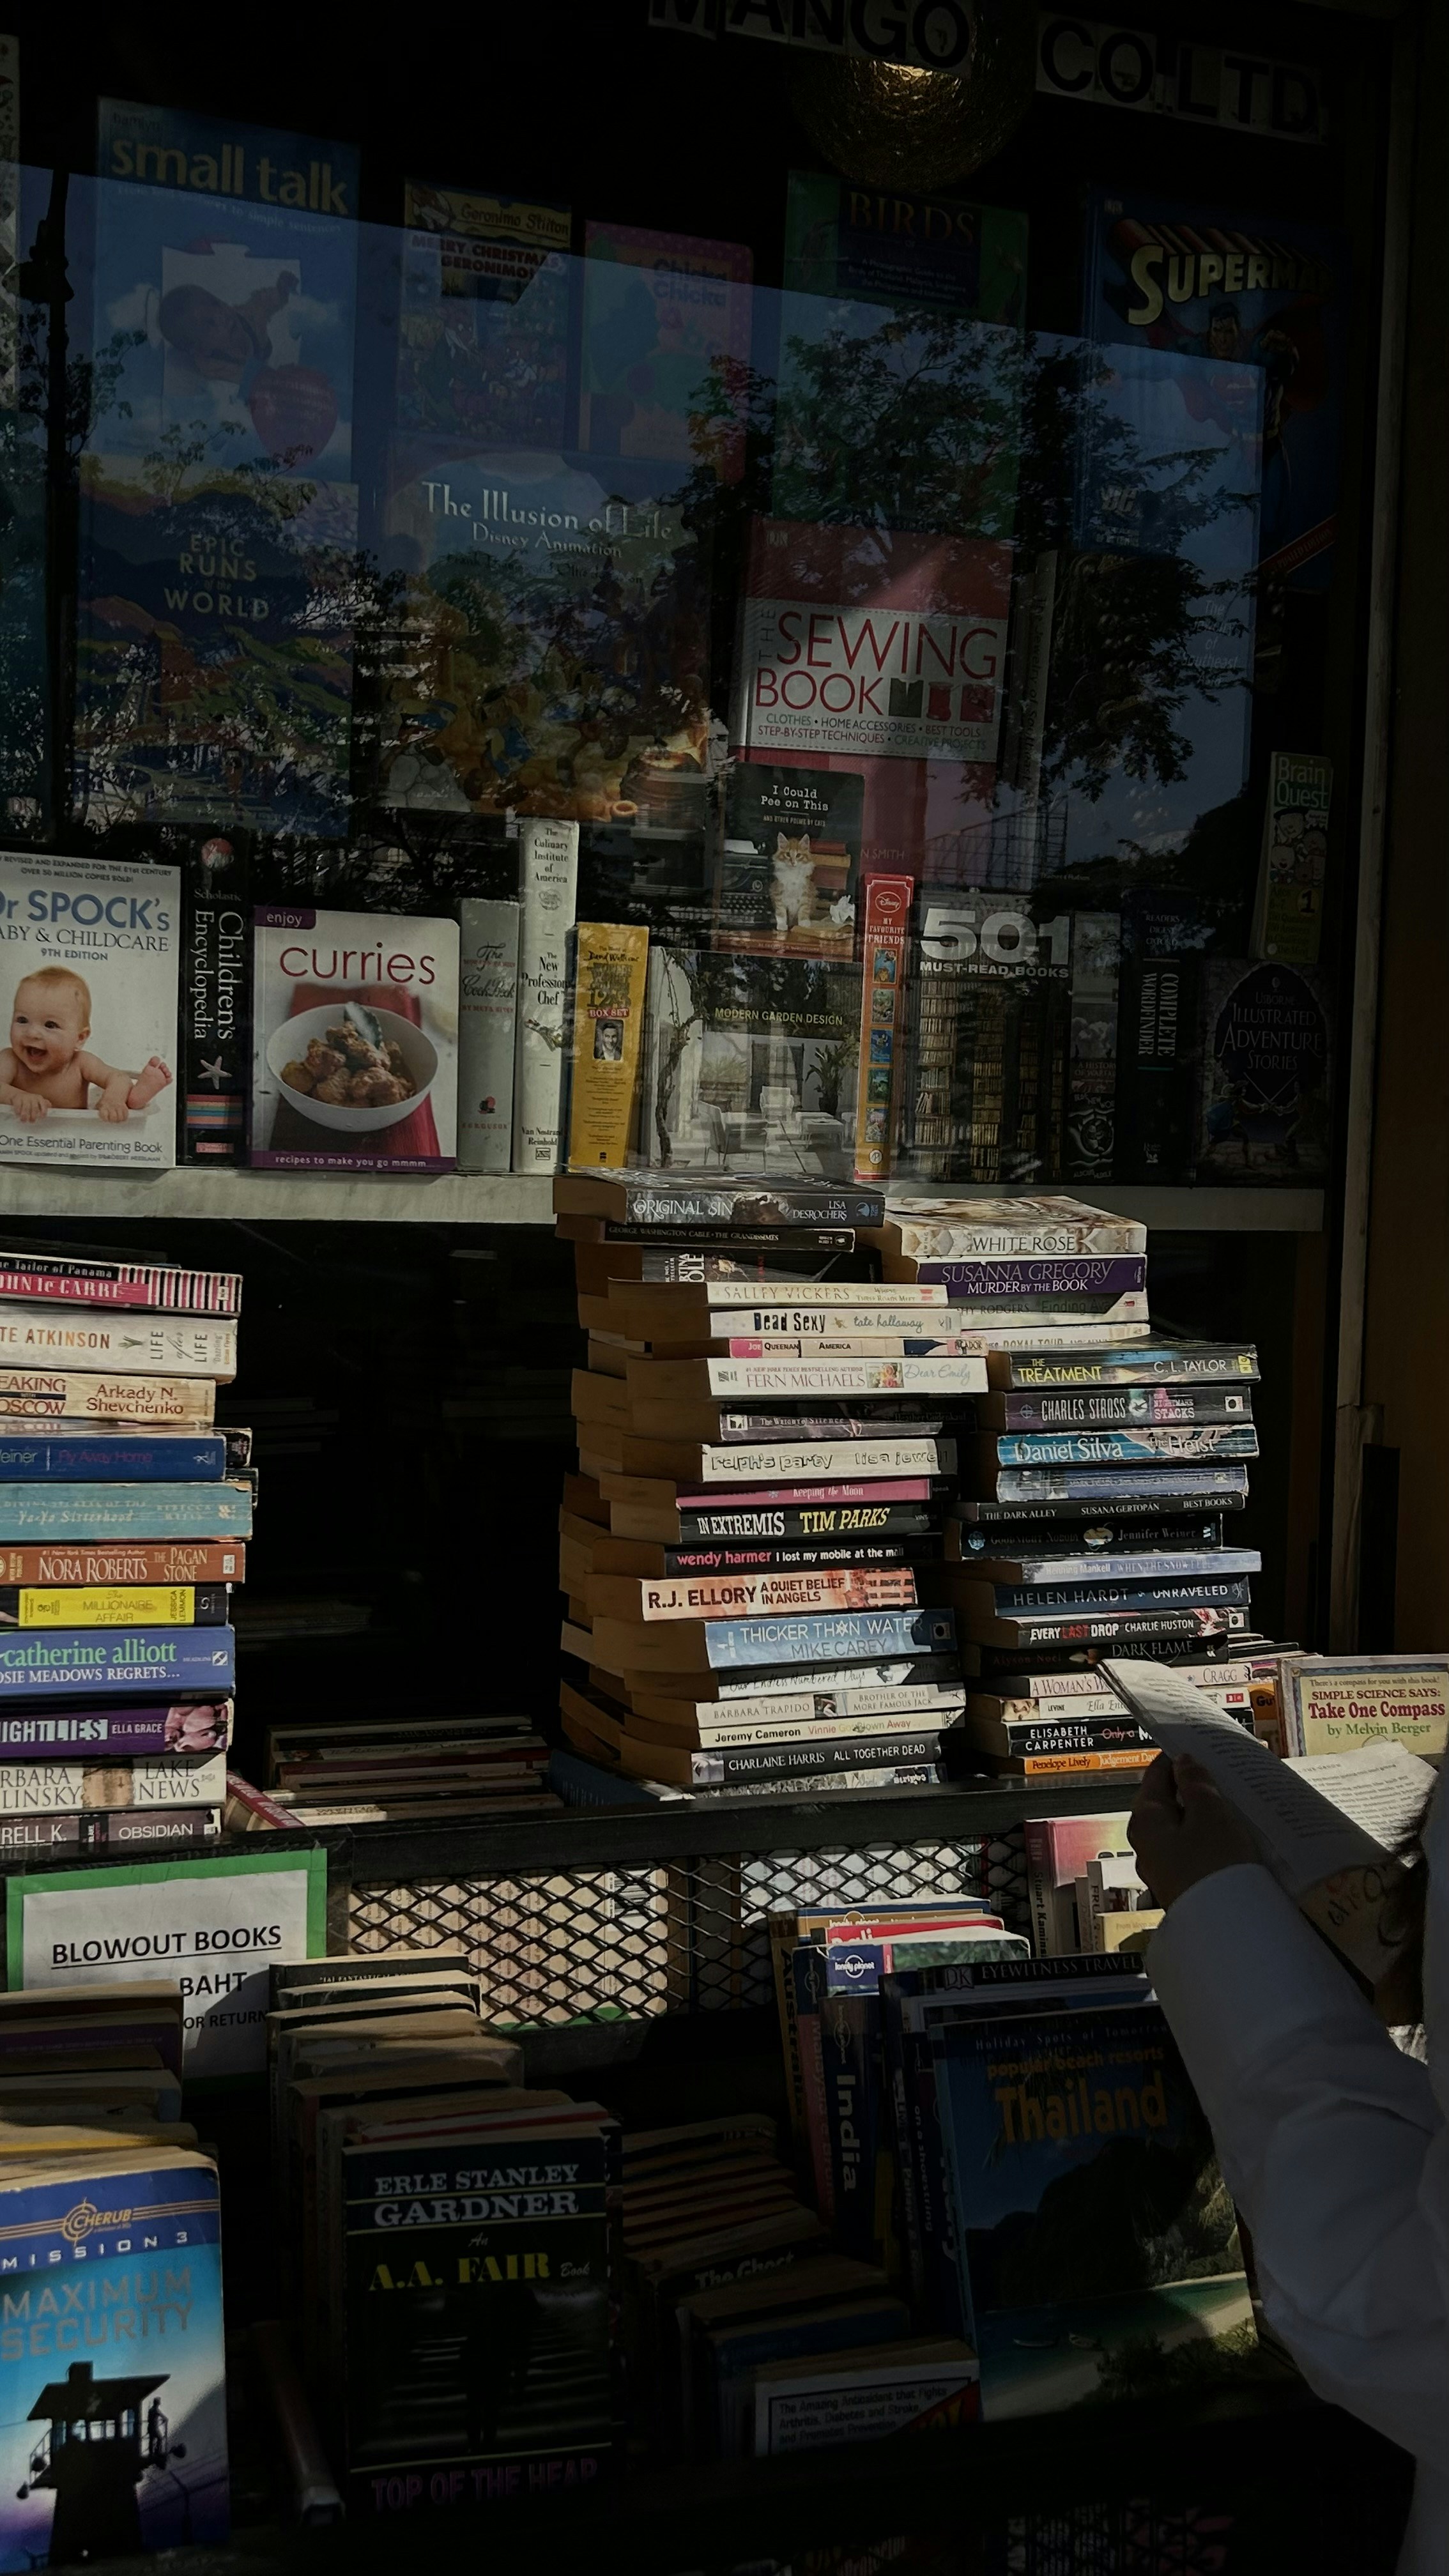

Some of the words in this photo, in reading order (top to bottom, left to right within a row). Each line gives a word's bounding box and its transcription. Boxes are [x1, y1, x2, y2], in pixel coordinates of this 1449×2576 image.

[648, 0, 972, 68] NGO
[111, 138, 245, 195] small
[257, 157, 348, 215] talk
[461, 203, 522, 229] Geronimo
[528, 213, 570, 236] Stilton
[850, 191, 976, 247] BIRDS
[1128, 244, 1337, 326] SUPERMAN
[420, 480, 472, 519] The
[482, 487, 579, 532] Illusion
[622, 505, 673, 540] Life
[192, 533, 245, 558] EPIC
[472, 521, 530, 549] Disney
[535, 531, 622, 558] Animation
[179, 552, 257, 583] RUNS
[164, 588, 270, 621] WORLD
[777, 610, 998, 679] SEWING
[755, 668, 884, 716] BOOK
[767, 714, 811, 726] CLOTHES
[821, 717, 852, 728] HOME
[853, 718, 916, 732] ACCESSORIES
[925, 724, 950, 735] BEST
[951, 726, 981, 737] TOOLS
[1278, 756, 1326, 789] Brain
[1276, 784, 1329, 810] Quest
[534, 838, 569, 852] Culinary
[534, 852, 569, 862] Institute
[533, 871, 567, 884] America
[1298, 889, 1315, 914] 1
[266, 912, 302, 928] enjoy
[920, 908, 1070, 965] 501
[194, 910, 214, 1039] Encyclopedia
[218, 911, 243, 1040] Children's
[280, 942, 436, 985] curries
[539, 957, 558, 972] New
[920, 962, 1008, 977] MUST-READ
[1016, 965, 1070, 979] BOOKS
[537, 991, 559, 1005] Chef
[715, 1007, 758, 1020] MODERN
[761, 1010, 803, 1022] GARDEN
[806, 1013, 843, 1025] DESIGN
[1138, 972, 1157, 1055] WORDFINDER
[1157, 972, 1180, 1058] COMPLETE
[1229, 1002, 1317, 1025] ILLUSTRATED
[1216, 1022, 1326, 1057] ADVENTURE
[1247, 1052, 1298, 1071] STORIES
[27, 1135, 76, 1153] Essential
[79, 1140, 131, 1156] Parenting
[134, 1143, 163, 1156] Book
[792, 1208, 847, 1222] DESROCHERS
[828, 1200, 847, 1210] LISA
[972, 1238, 1027, 1252] WHITE
[1032, 1235, 1075, 1251] ROSE
[940, 1262, 1022, 1284] SUSANNA
[1028, 1259, 1116, 1285] GREGORY
[724, 1287, 777, 1300] SALLEY
[785, 1286, 850, 1300] VICKERS
[26, 1328, 110, 1349] ATKINSON
[150, 1331, 164, 1360] LIFE
[194, 1333, 208, 1363] LIFE
[746, 1373, 788, 1388] FERN
[791, 1371, 866, 1388] MICHAELS
[1017, 1366, 1102, 1383] TREATMENT
[86, 1397, 184, 1414] Shevchenko
[1041, 1399, 1085, 1422] CHARLES
[1089, 1398, 1126, 1419] STROSS
[1154, 1407, 1195, 1420] STACKS
[696, 1517, 710, 1534] IN
[710, 1512, 785, 1536] EXTREMIS
[799, 1510, 836, 1534] TIM
[839, 1507, 891, 1530] PARKS
[169, 1547, 208, 1565] PAGAN
[678, 1551, 723, 1566] wendy
[725, 1550, 772, 1565] harmer
[782, 1549, 801, 1561] lost
[802, 1549, 818, 1563] my
[820, 1547, 852, 1560] mobile
[854, 1549, 865, 1560] at
[867, 1546, 884, 1559] the
[885, 1545, 905, 1557] mall
[38, 1556, 85, 1581] NORA
[86, 1556, 148, 1583] ROBERTS
[164, 1564, 198, 1582] STONE
[648, 1592, 683, 1608] R.J.
[688, 1585, 757, 1606] ELLORY
[1013, 1591, 1068, 1607] HELEN
[1074, 1588, 1130, 1604] HARDT
[1153, 1584, 1229, 1600] UNRAVELED
[82, 1600, 153, 1611] MILLIONAIRE
[95, 1612, 134, 1623] AFFAIR
[740, 1623, 809, 1643] THICKER
[866, 1616, 924, 1634] WATER
[1030, 1626, 1061, 1644] EVERY
[1062, 1624, 1089, 1639] LAST
[1090, 1623, 1119, 1637] DROP
[1124, 1621, 1159, 1633] CHARLIE
[1160, 1619, 1194, 1630] HUSTON
[4, 1640, 107, 1667] catherine
[112, 1638, 178, 1663] alliott
[791, 1642, 831, 1659] MIKE
[834, 1637, 887, 1655] CAREY
[1112, 1643, 1147, 1659] DARK
[1151, 1640, 1194, 1656] FLAME
[1202, 1667, 1238, 1683] CRAGG
[1312, 1689, 1355, 1701] SIMPLE
[1357, 1688, 1406, 1700] SCIENCE
[1408, 1687, 1441, 1699] SAYS:
[1308, 1701, 1346, 1720] Take
[1349, 1701, 1377, 1717] One
[1380, 1701, 1446, 1721] Compass
[715, 1731, 753, 1744] Jeremy
[755, 1727, 802, 1740] Cameron
[808, 1724, 836, 1736] Vinnie
[886, 1719, 911, 1731] Away
[1030, 1726, 1088, 1739] ELISABETH
[1327, 1723, 1343, 1737] by
[1346, 1721, 1389, 1735] Melvin
[1392, 1722, 1432, 1735] Berger
[1025, 1737, 1094, 1752] CARPENTER
[145, 1759, 195, 1781] LAKE
[728, 1755, 786, 1772] CHARLAINE
[788, 1751, 826, 1765] HARRIS
[833, 1749, 851, 1761] ALL
[853, 1745, 900, 1759] TOGETHER
[902, 1744, 926, 1757] DEAD
[139, 1779, 201, 1800] NEWS
[119, 1823, 193, 1840] OBSIDIAN
[52, 1932, 186, 1965] BLOWOUT
[194, 1925, 281, 1951] BOOKS
[180, 1972, 248, 1997] BAHT
[995, 2069, 1169, 2143] Thailand
[836, 2074, 861, 2193] India
[374, 2174, 448, 2196] ERLE
[455, 2164, 579, 2191] STANLEY
[374, 2190, 579, 2227] GARDNER
[368, 2260, 445, 2291] A.A.
[457, 2251, 551, 2285] FAIR
[3, 2267, 192, 2324] MAXIMUM
[0, 2300, 192, 2361] SECURITY
[371, 2474, 422, 2512] TOP
[429, 2469, 466, 2504] OF
[470, 2465, 521, 2501] THE
[528, 2457, 599, 2490] HEAP
